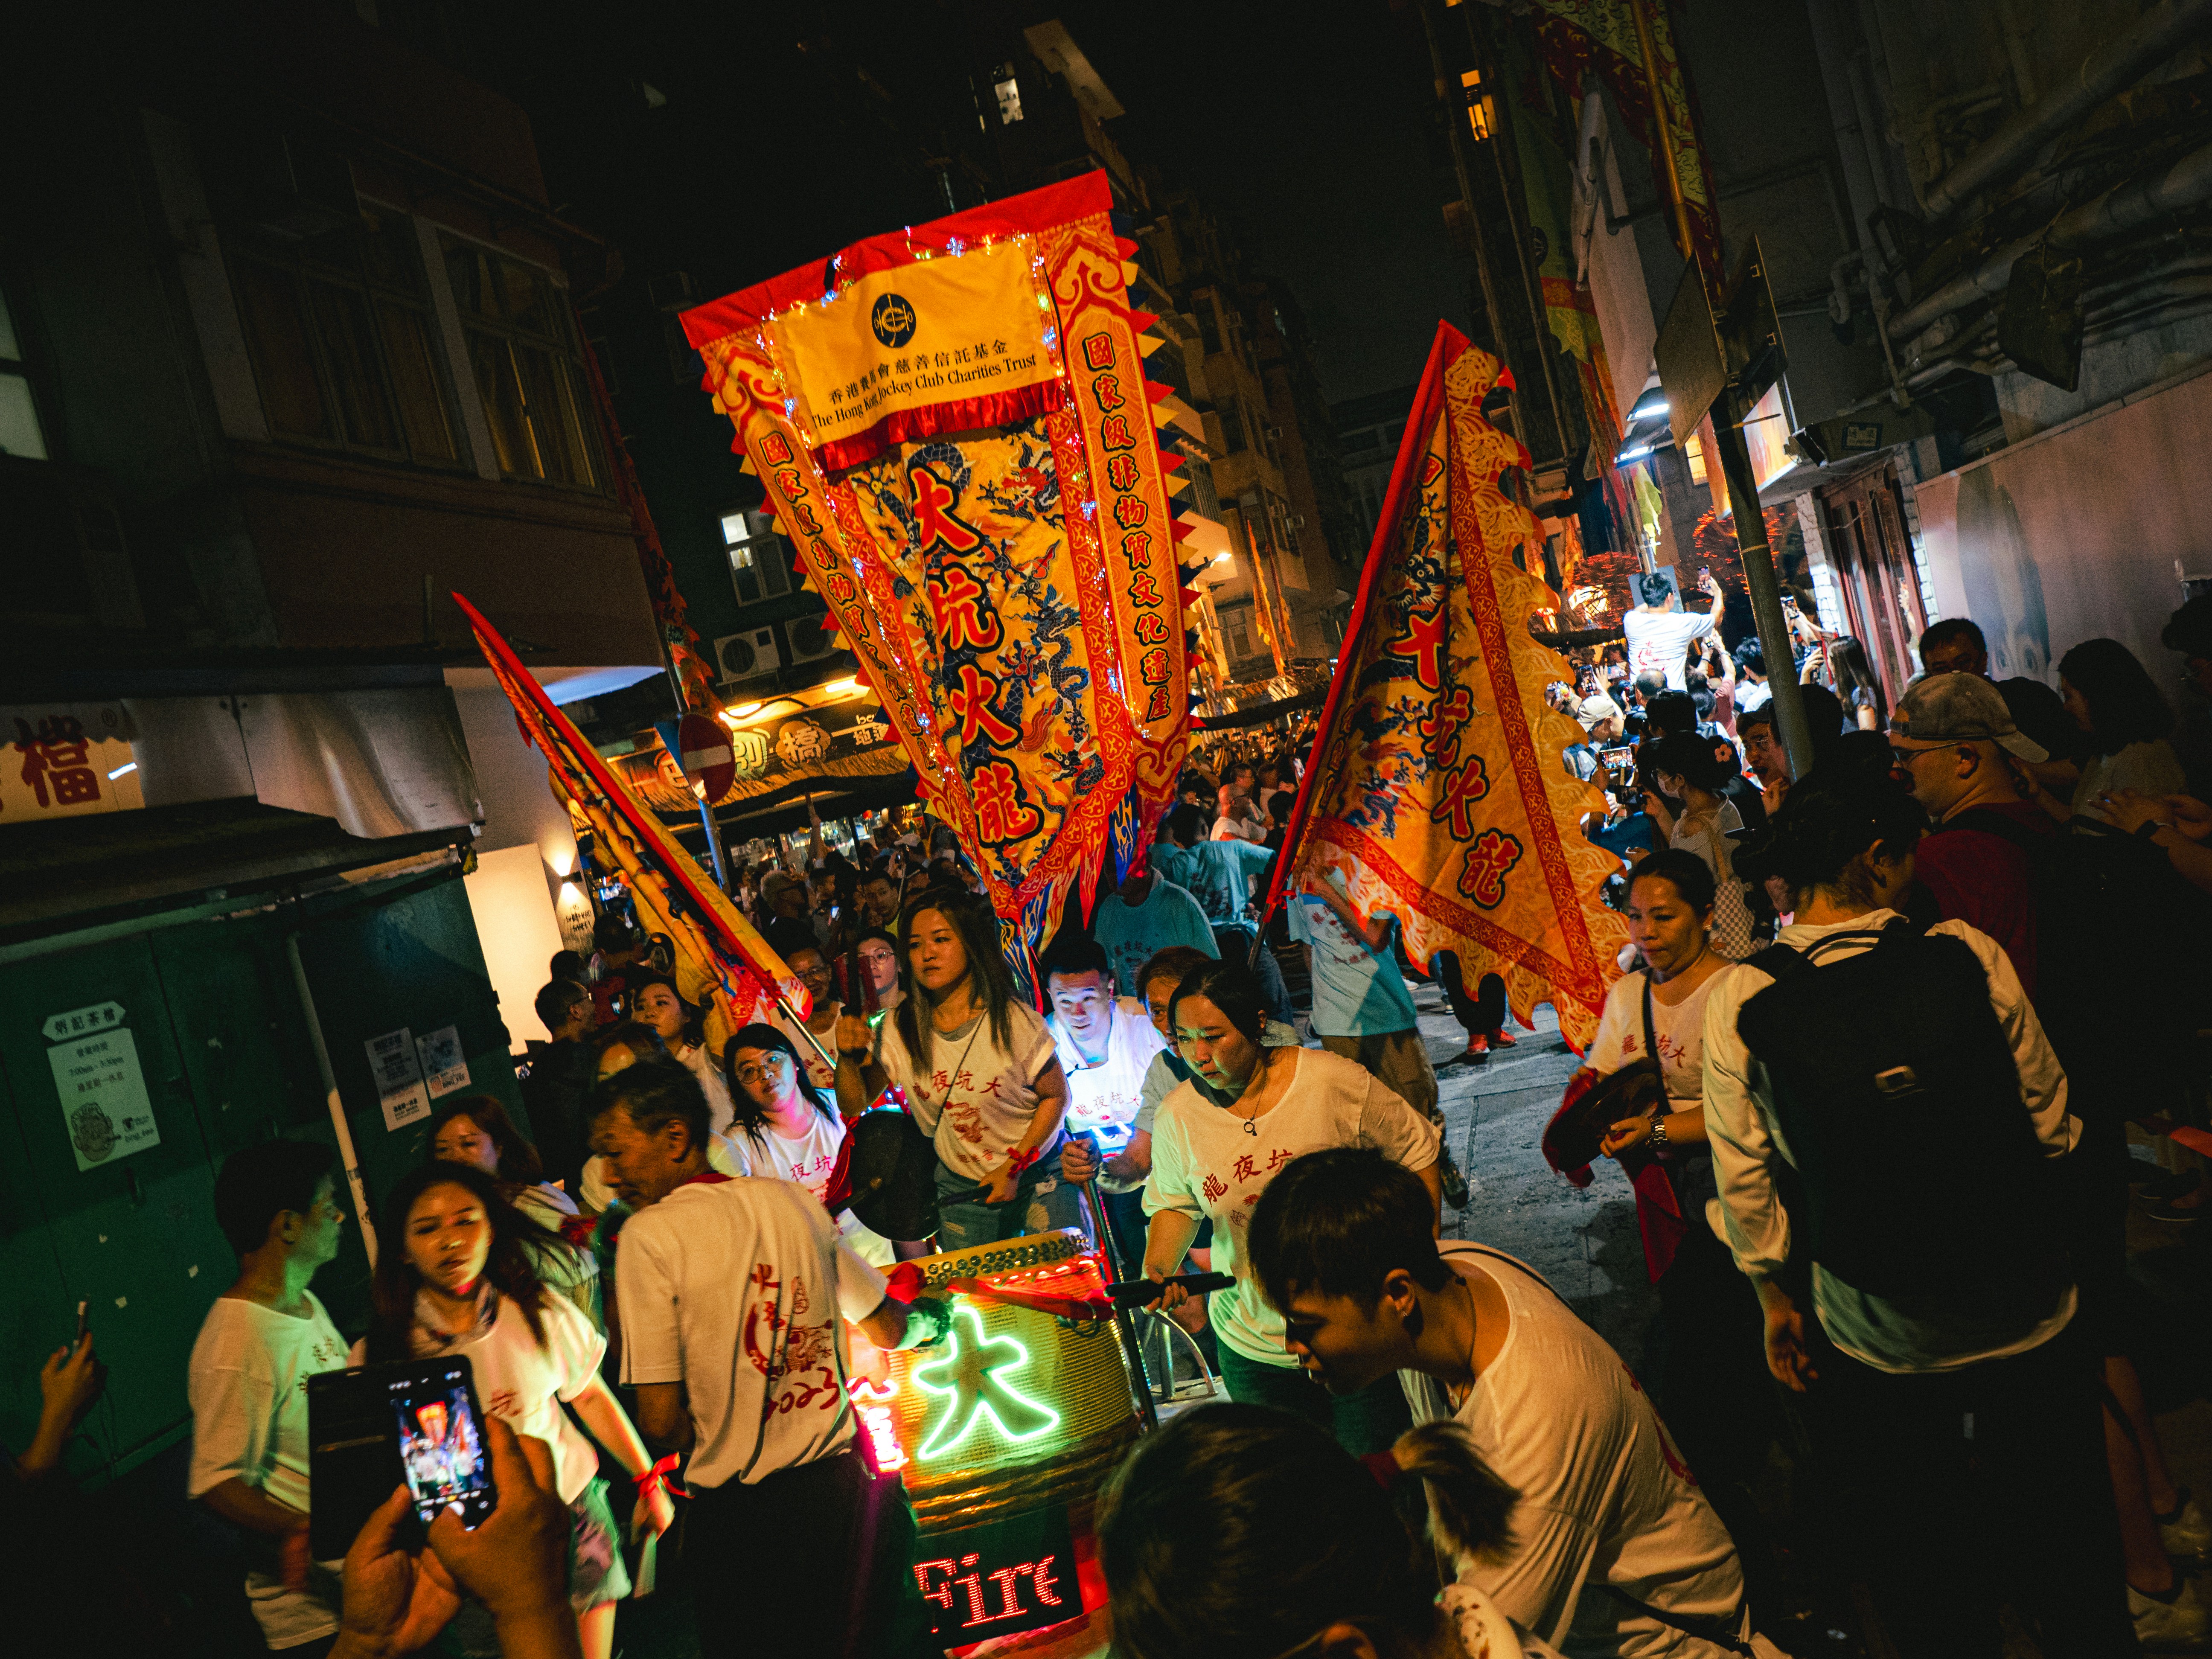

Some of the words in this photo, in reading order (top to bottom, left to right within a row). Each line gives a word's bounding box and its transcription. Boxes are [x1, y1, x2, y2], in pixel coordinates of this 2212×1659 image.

[811, 412, 833, 429] The
[834, 404, 863, 422] Hong
[877, 379, 913, 403] Jockey
[914, 370, 945, 390] Club
[947, 363, 1002, 385] Charities
[1003, 354, 1037, 373] Trust
[907, 463, 1044, 849] 大坑火龍
[1083, 332, 1171, 724] 國家級非物質文化遺產
[909, 1302, 1062, 1461] 大
